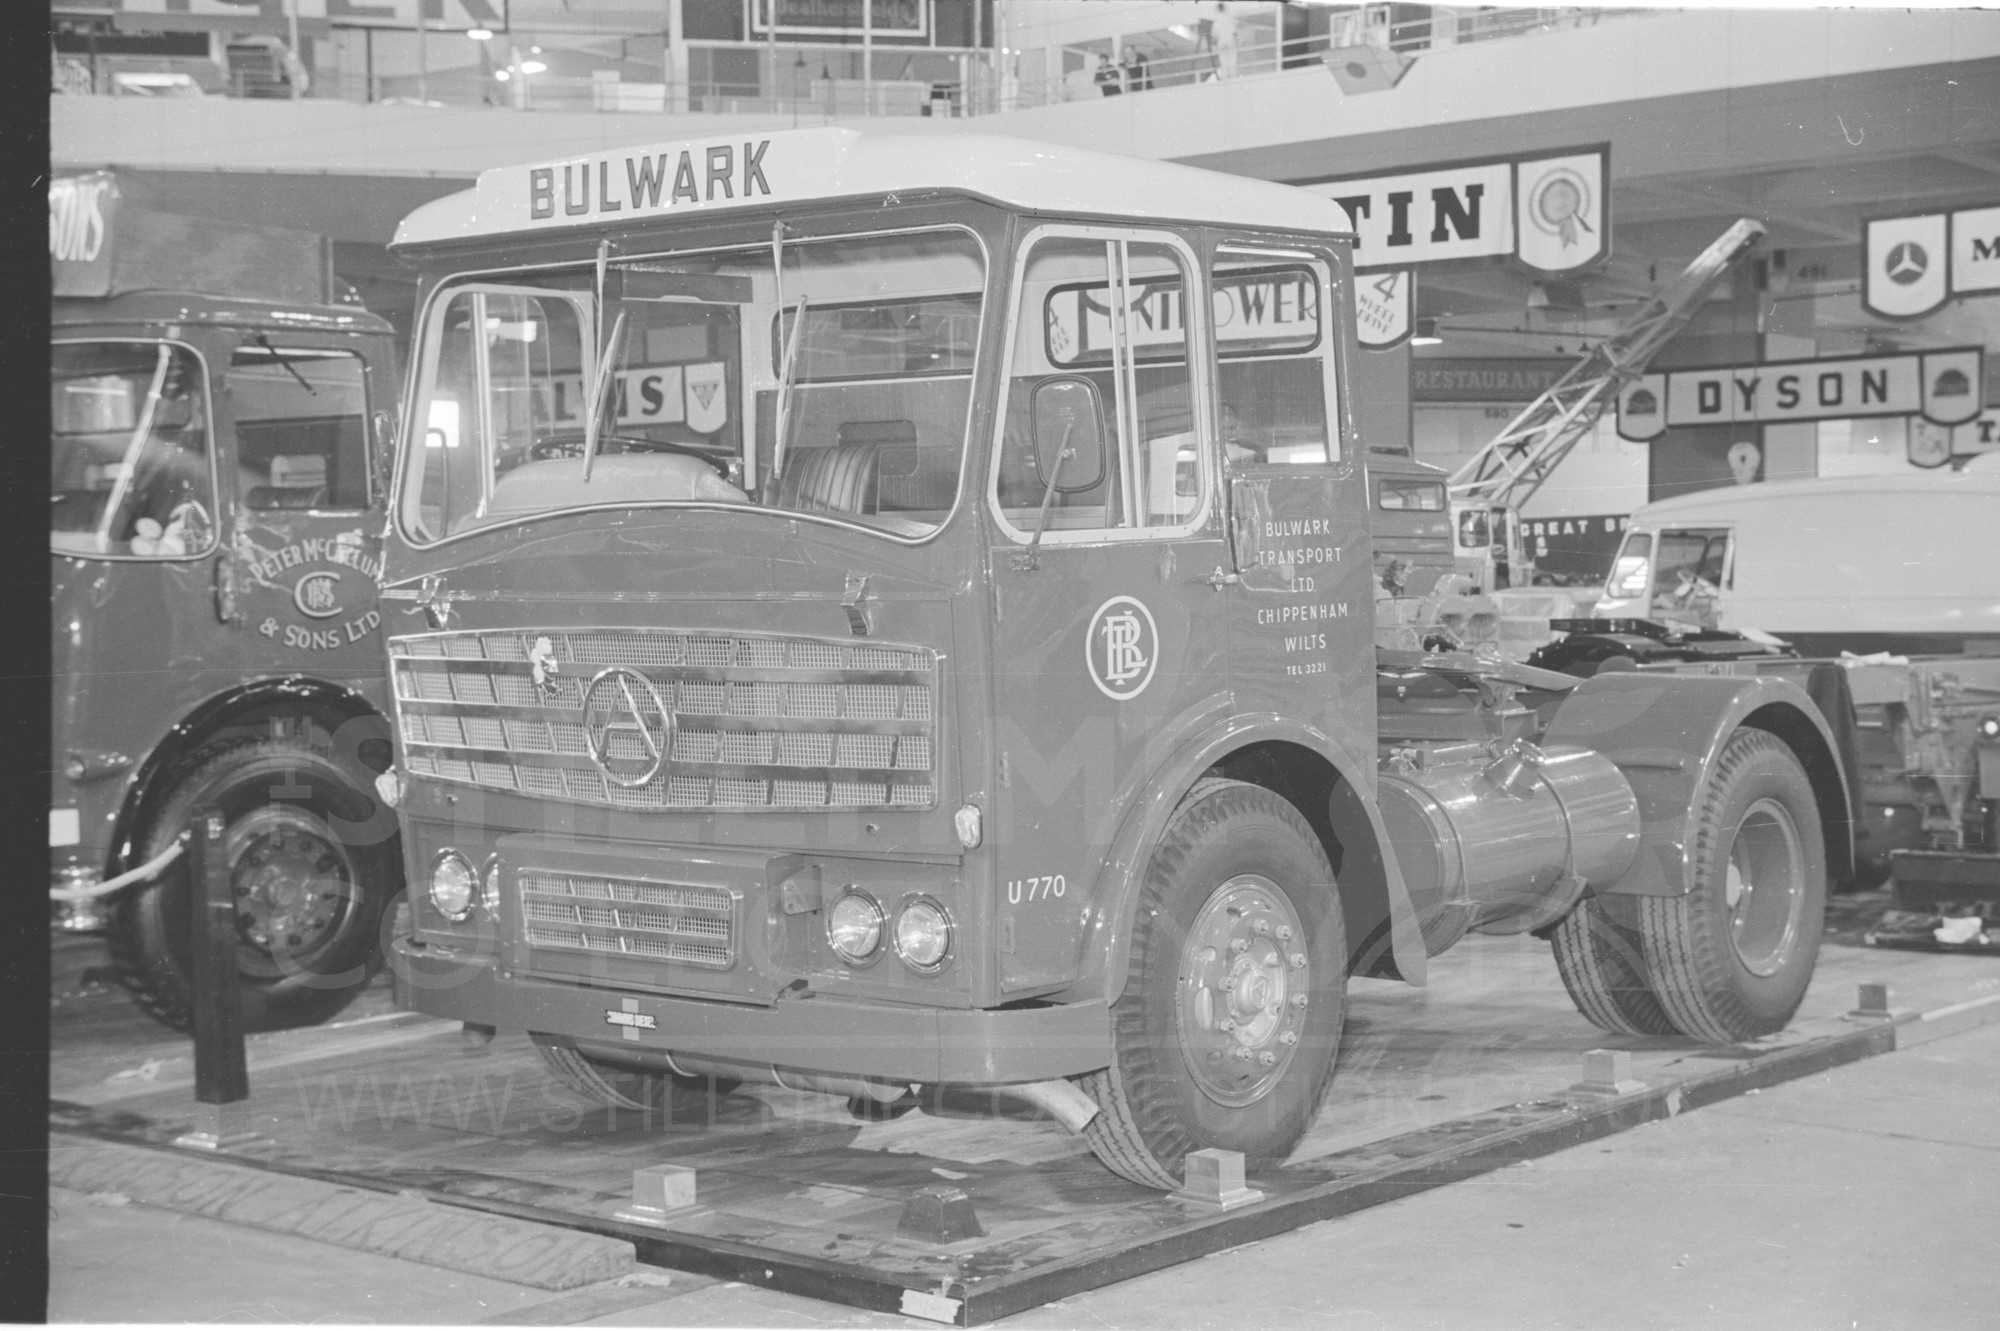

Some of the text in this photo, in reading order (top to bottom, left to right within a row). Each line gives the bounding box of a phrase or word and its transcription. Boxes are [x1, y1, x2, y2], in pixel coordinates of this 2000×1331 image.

[530, 140, 771, 220] BULWARK
[1333, 183, 1484, 250] TIN
[1414, 370, 1556, 390] RESTAURANT
[1698, 369, 1887, 415] DYSON
[1265, 519, 1330, 537] BULWARK
[1520, 520, 1588, 537] GREAT
[248, 543, 303, 580] PETER
[1259, 547, 1342, 566] TRANSPORT
[1257, 602, 1349, 625] CHIPPENHAM
[259, 610, 381, 650] & SONS LTD
[1284, 633, 1327, 653] WILTS
[1305, 662, 1327, 675] 3221
